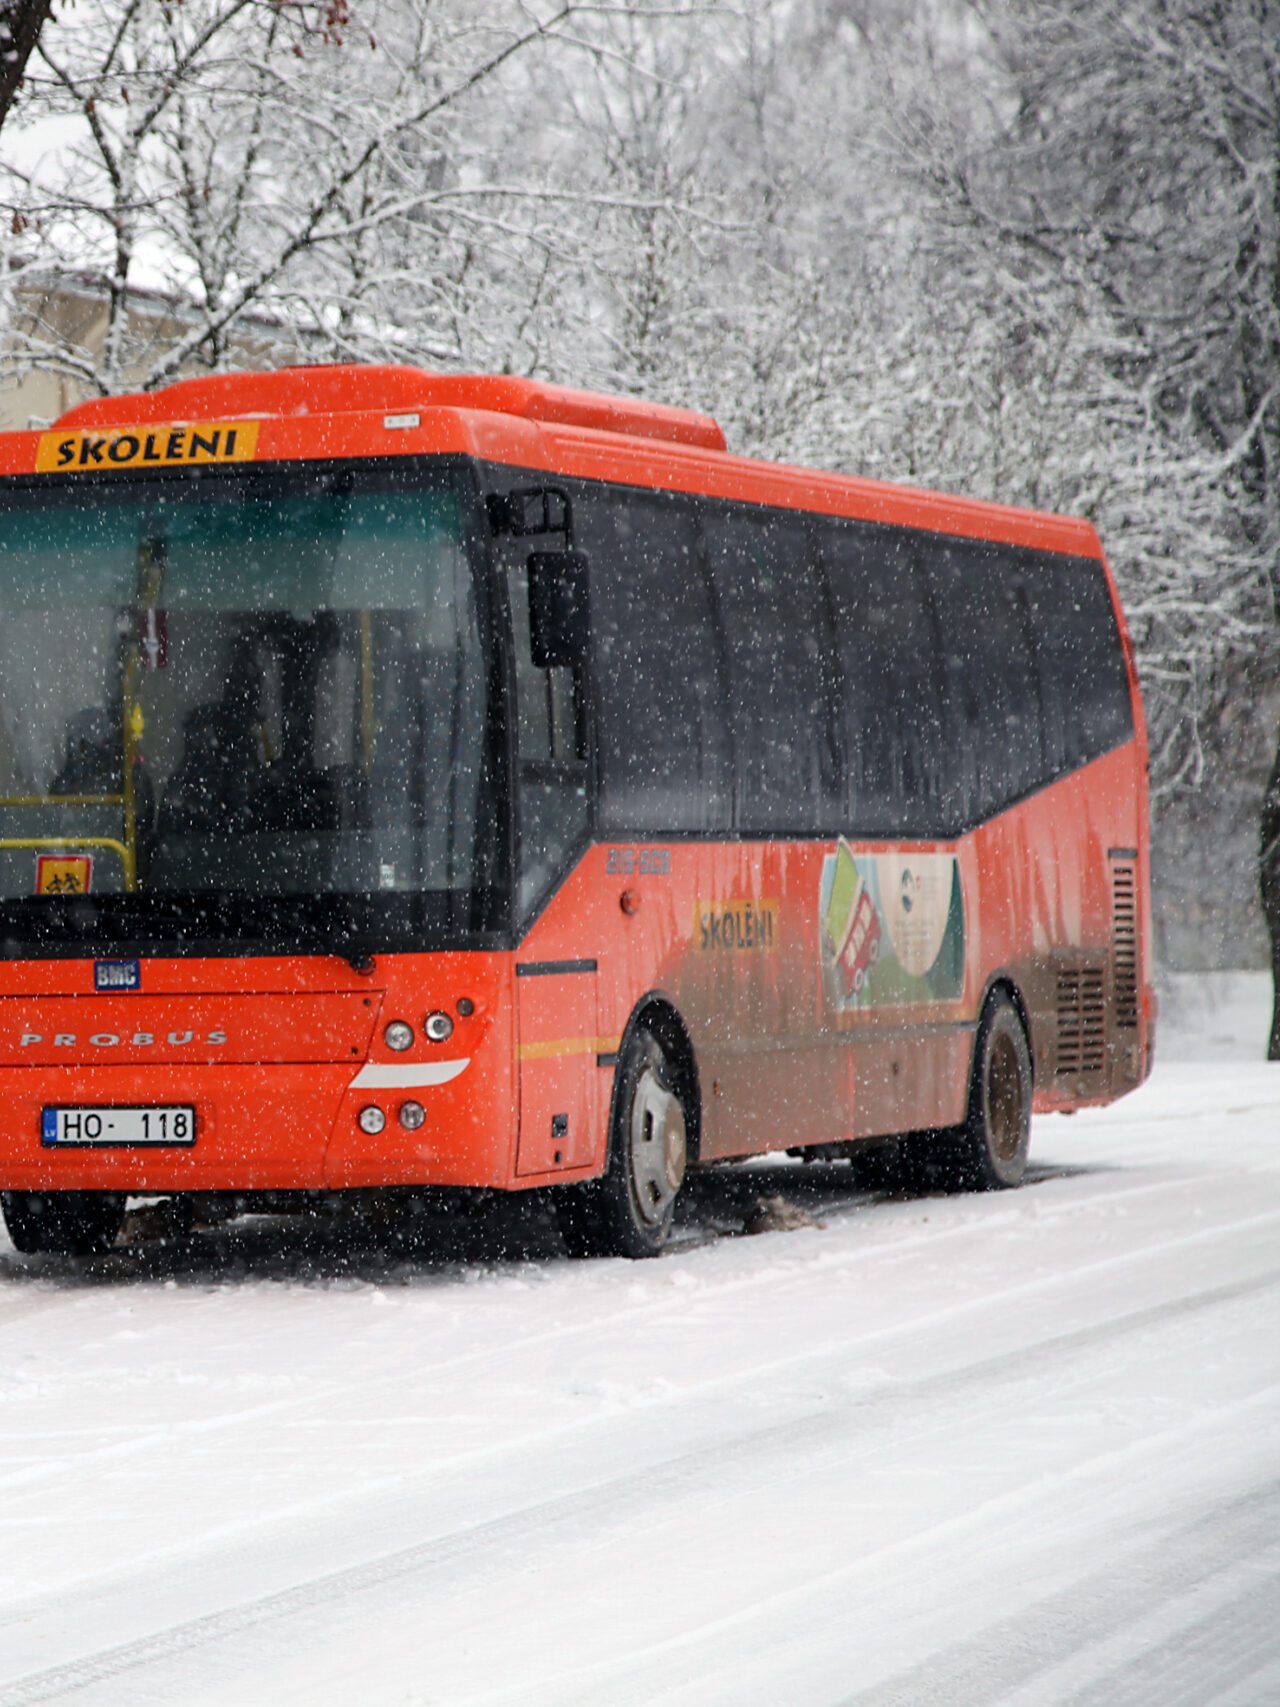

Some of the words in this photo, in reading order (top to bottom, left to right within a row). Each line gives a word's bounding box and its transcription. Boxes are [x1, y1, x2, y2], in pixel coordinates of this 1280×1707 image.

[57, 427, 237, 466] SKOLĒNI
[701, 903, 773, 951] SKOLĒNI
[97, 964, 136, 986] BMC
[20, 1030, 228, 1047] PROBUS
[44, 1129, 56, 1138] LV
